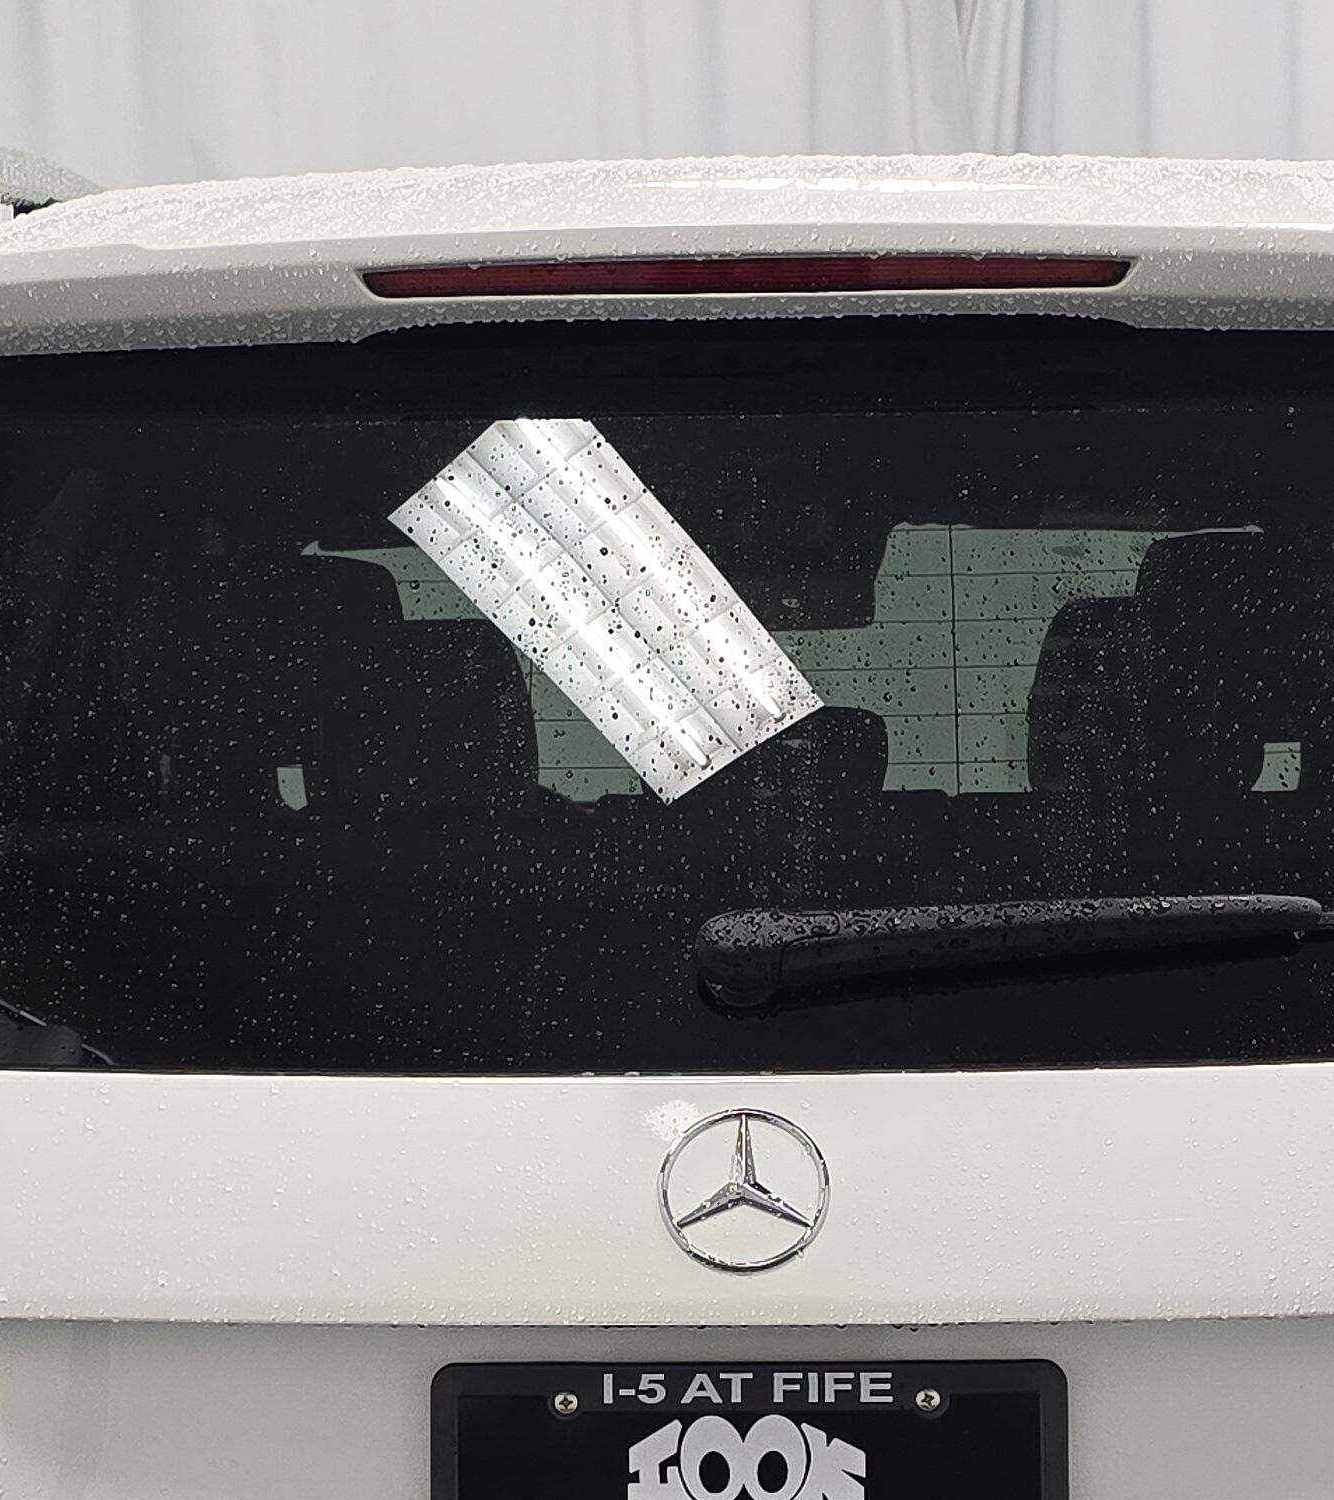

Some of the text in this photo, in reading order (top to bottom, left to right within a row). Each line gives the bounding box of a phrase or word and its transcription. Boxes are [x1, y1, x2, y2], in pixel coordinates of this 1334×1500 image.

[602, 1372, 894, 1404] I-5 AT FIFE
